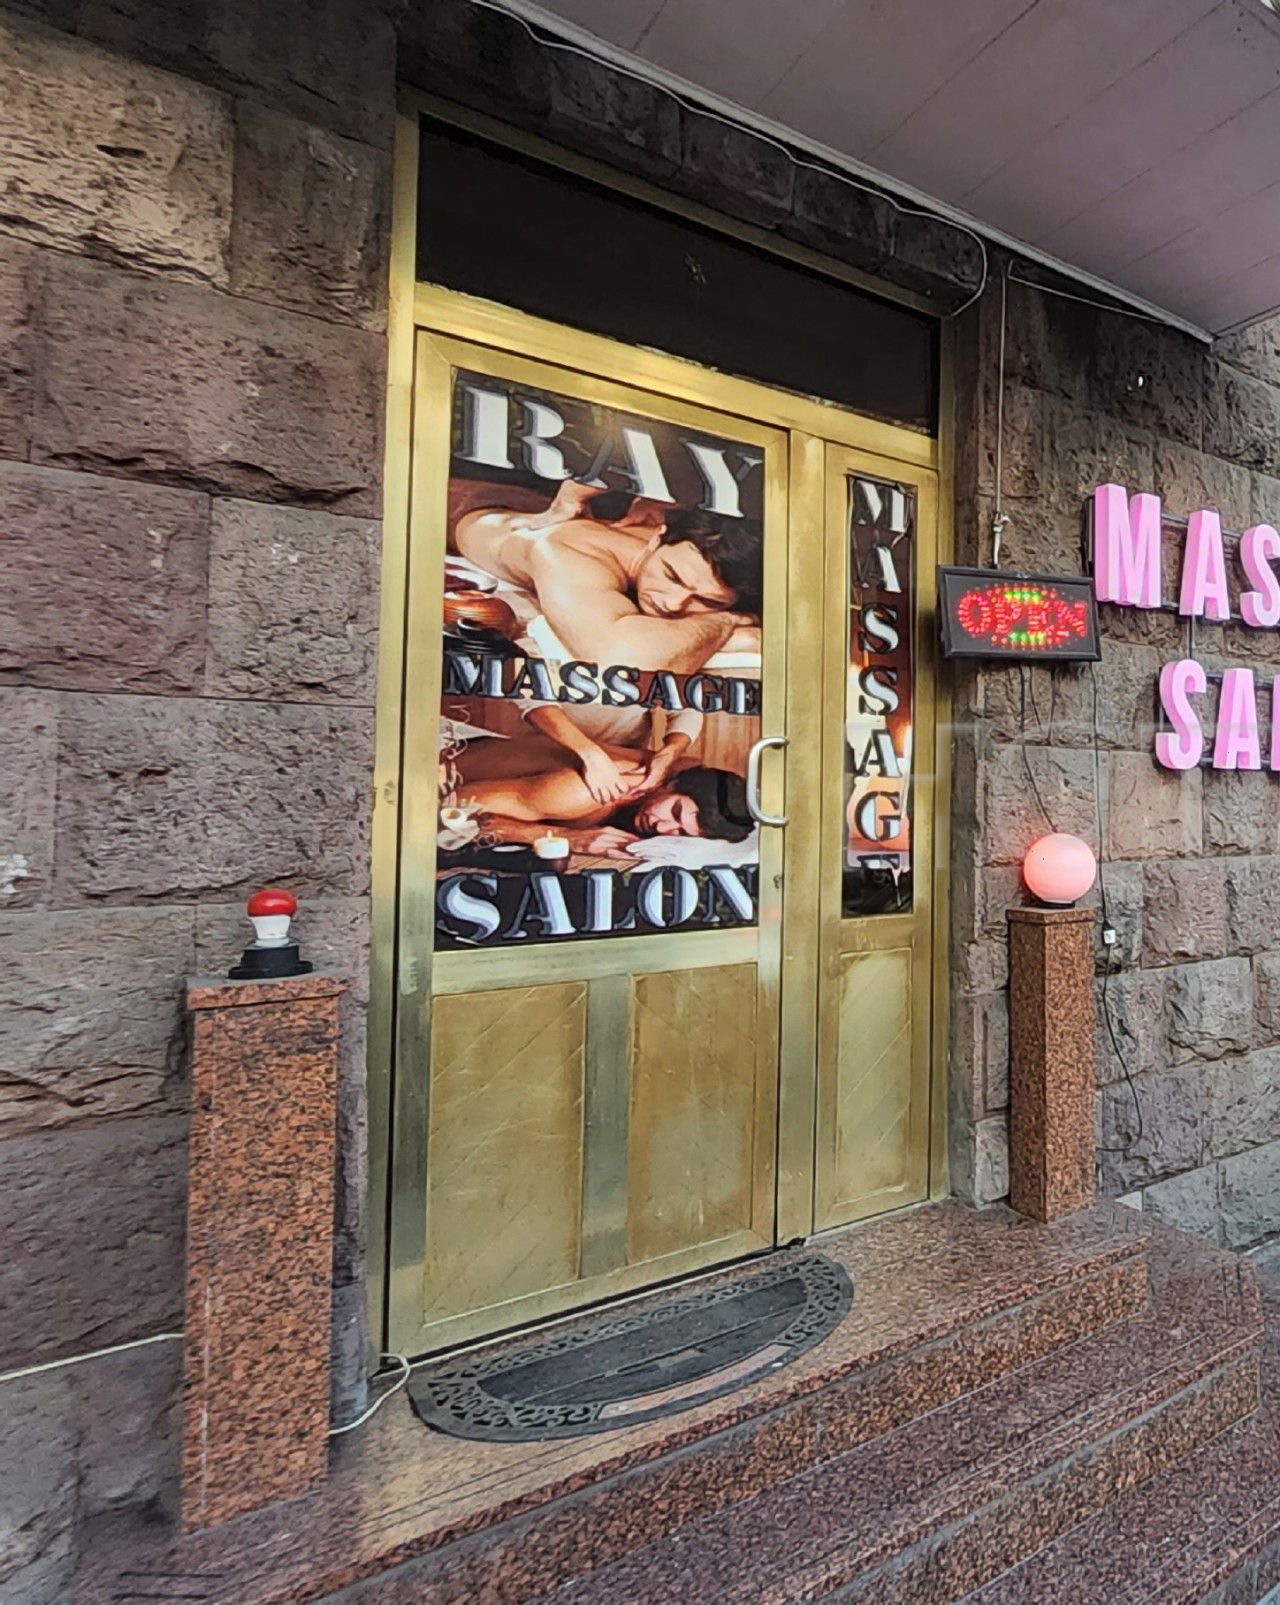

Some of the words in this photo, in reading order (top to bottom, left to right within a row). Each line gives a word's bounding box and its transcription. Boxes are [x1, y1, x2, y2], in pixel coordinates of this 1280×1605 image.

[453, 386, 764, 518] RAY
[958, 590, 1088, 638] OPEN
[442, 652, 762, 716] MASSAGE
[436, 864, 757, 946] SALON
